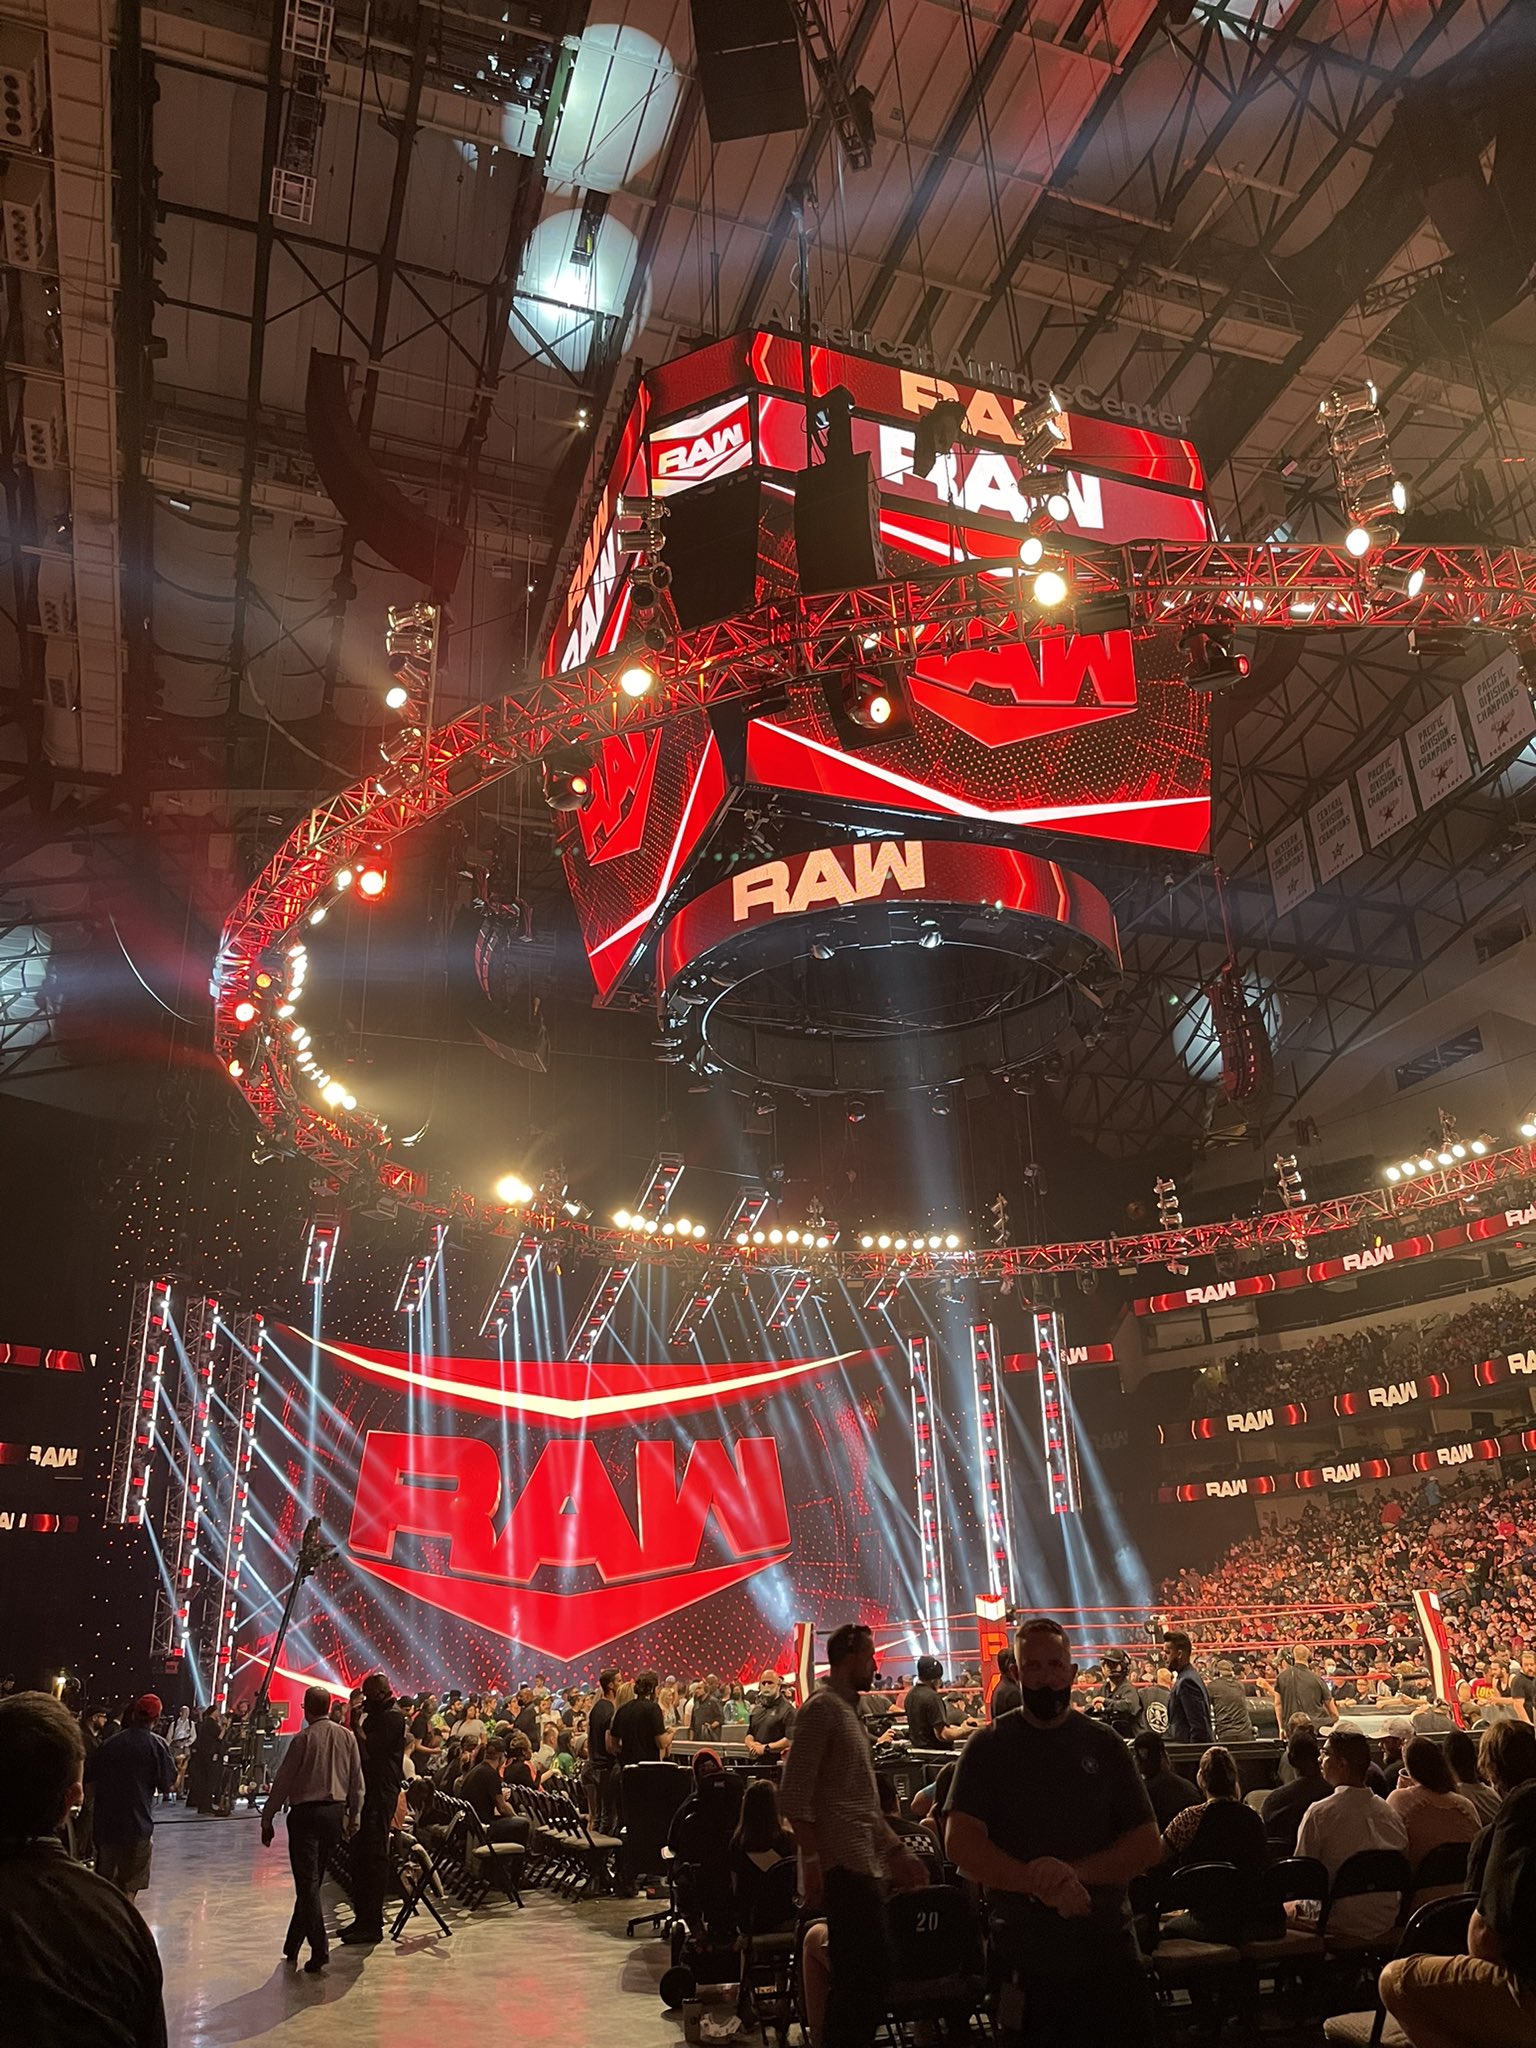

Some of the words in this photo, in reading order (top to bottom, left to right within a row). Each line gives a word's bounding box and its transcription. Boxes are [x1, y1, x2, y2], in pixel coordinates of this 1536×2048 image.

[658, 423, 744, 476] RAW
[1477, 666, 1506, 696] PACIFIC
[1478, 677, 1511, 709] DIVISION
[1476, 687, 1520, 724] CHAMPIONS
[1418, 715, 1446, 742] PACIFIC
[1420, 726, 1449, 755] DIVISION
[1368, 757, 1392, 781] PACIFIC
[1418, 733, 1457, 770] CHAMPIONS
[1368, 775, 1403, 809] CHAMPIONS
[1370, 767, 1395, 794] DIVISION
[732, 840, 926, 922] RAW
[1186, 1281, 1236, 1304] RAW
[1343, 1245, 1394, 1271] RAW
[1227, 1409, 1273, 1432] RAW
[1368, 1381, 1418, 1406] RAW
[1206, 1479, 1247, 1498] RAW
[1322, 1463, 1361, 1483] RAW
[1437, 1443, 1473, 1466] RAW
[348, 1430, 792, 1584] RAW
[915, 1911, 939, 1932] 20
